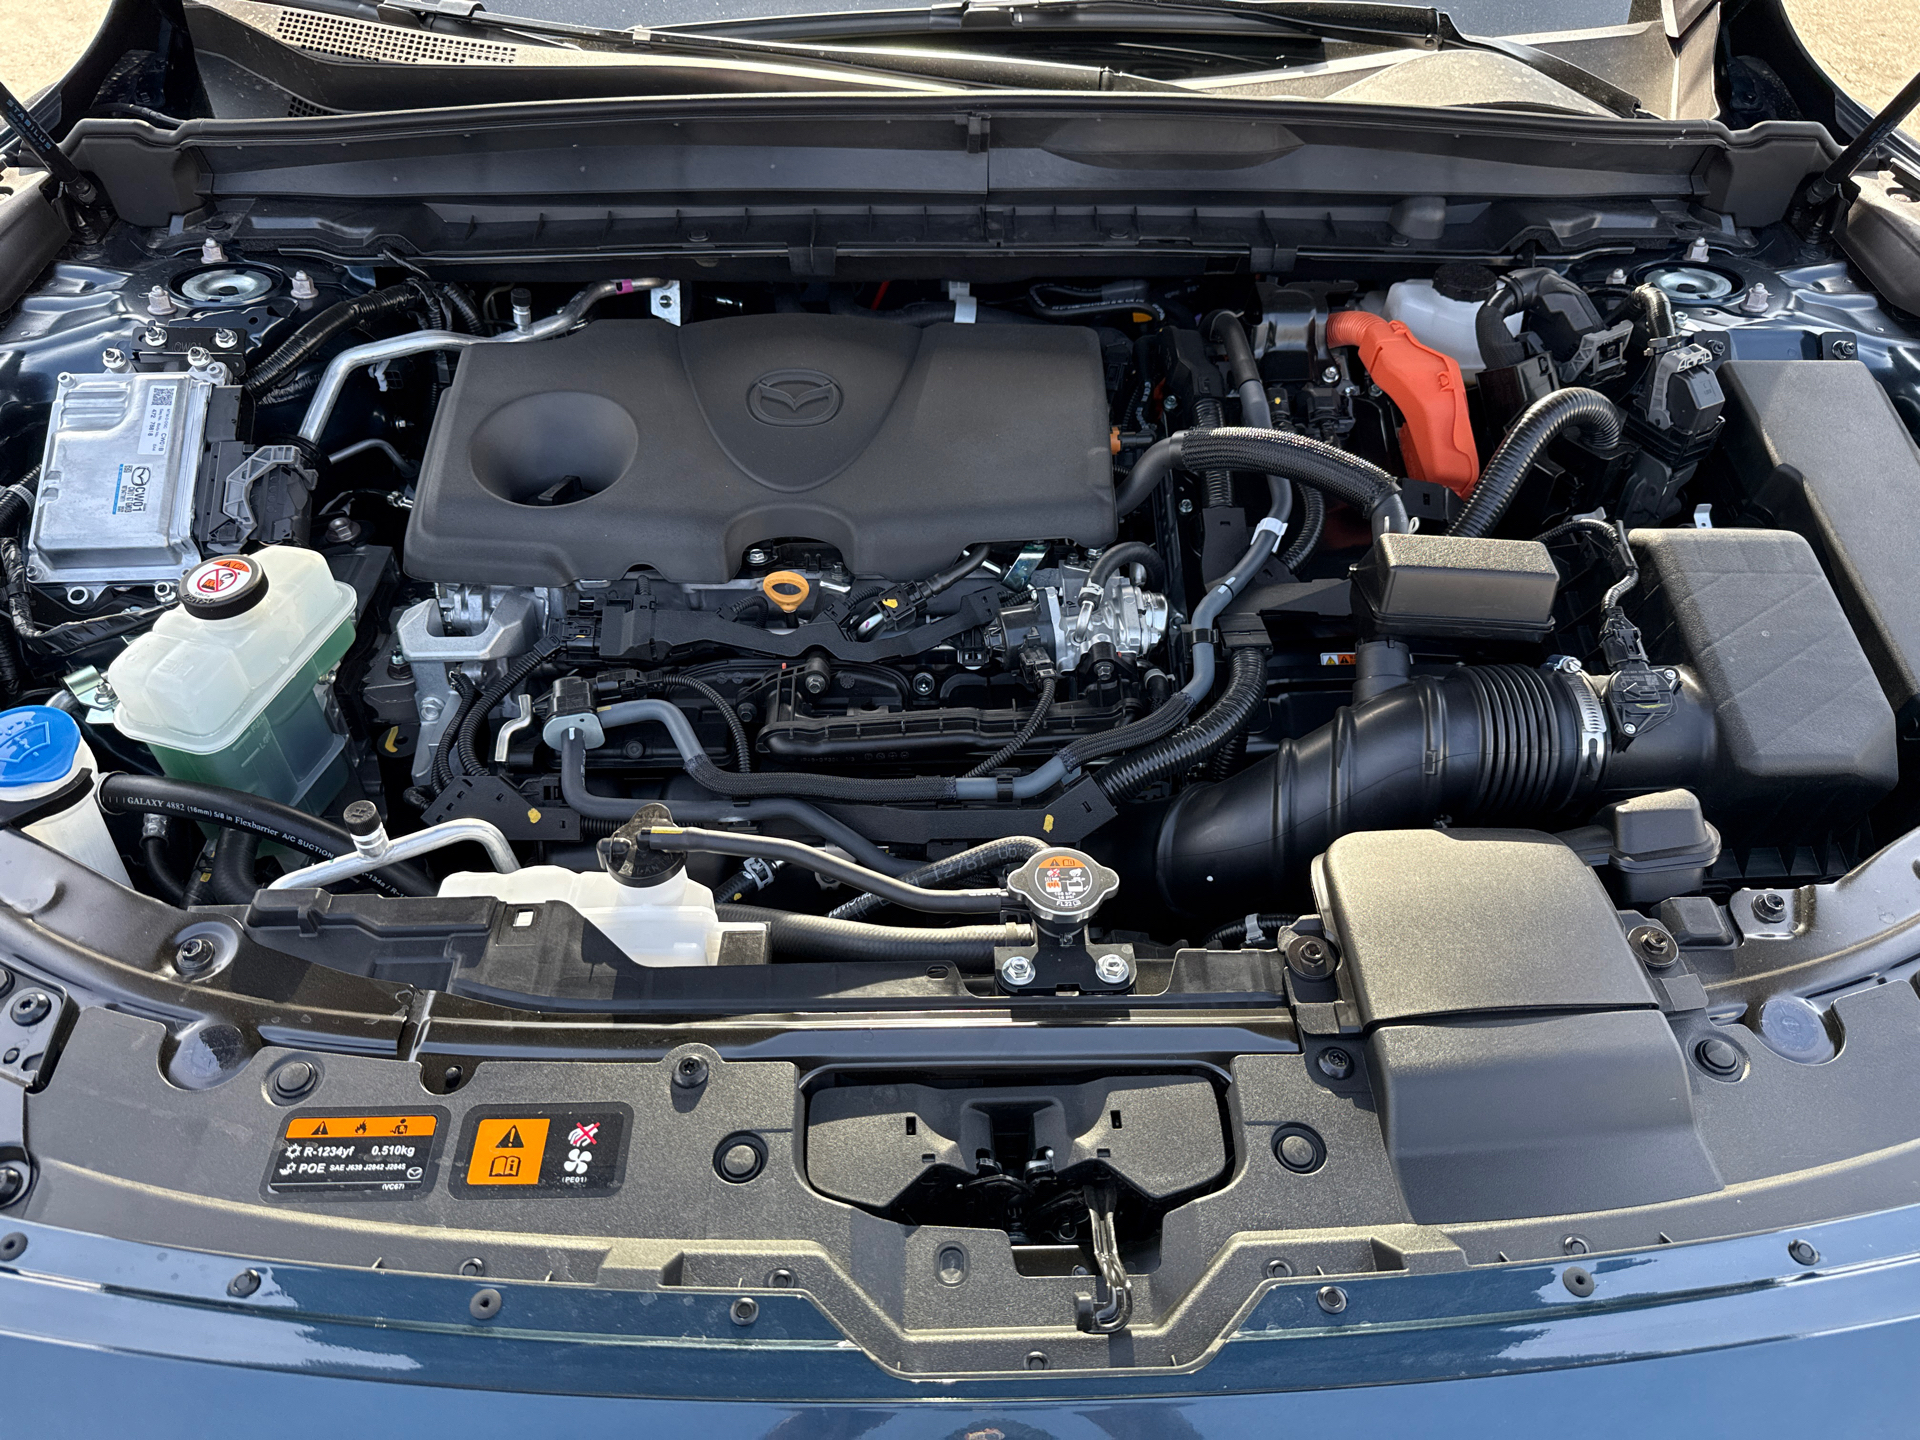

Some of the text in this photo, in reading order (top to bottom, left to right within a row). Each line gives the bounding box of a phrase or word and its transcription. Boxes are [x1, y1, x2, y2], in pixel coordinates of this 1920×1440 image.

[6, 99, 52, 150] STABILUS
[127, 796, 164, 808] GALAXY
[166, 800, 185, 812] 4882
[234, 816, 279, 837] Flexbarrier
[282, 832, 296, 843] A/C
[297, 839, 334, 859] SUCTION
[361, 872, 386, 888] -134a
[303, 1144, 416, 1158] R-1234yf 0.510kg
[298, 1163, 326, 1174] POE
